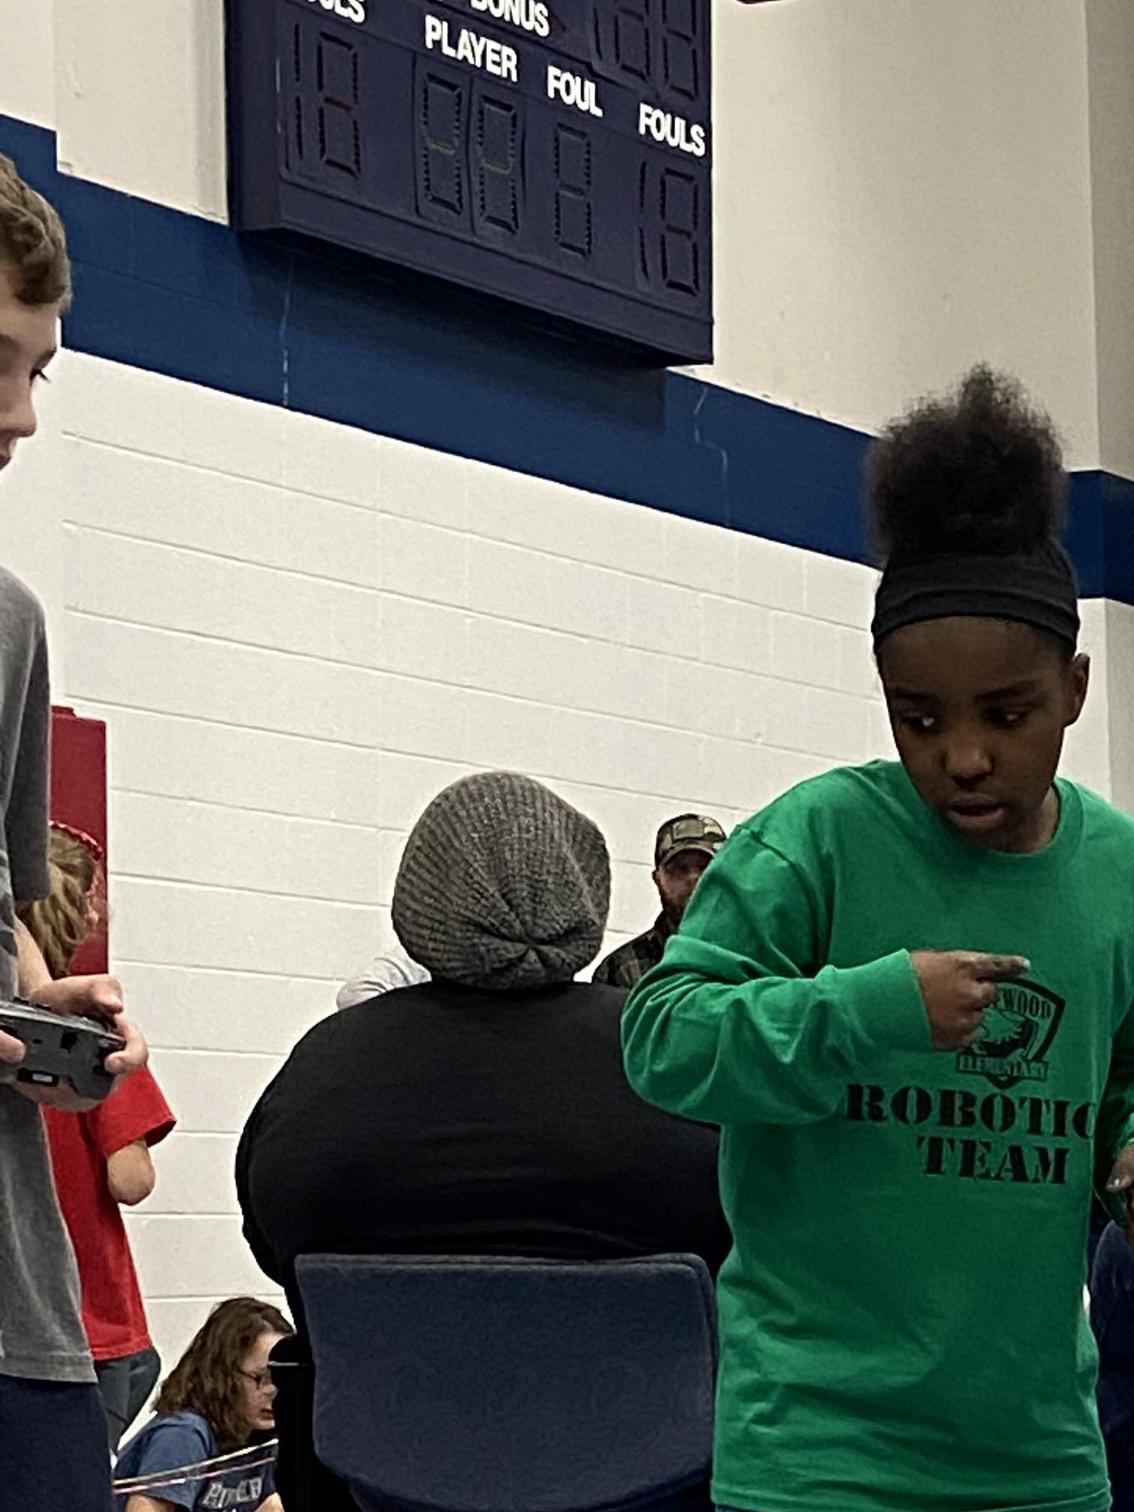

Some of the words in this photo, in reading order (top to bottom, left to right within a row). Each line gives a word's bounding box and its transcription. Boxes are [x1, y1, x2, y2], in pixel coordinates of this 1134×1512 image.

[425, 14, 518, 82] PLAYER
[547, 66, 602, 117] FOUL
[638, 103, 706, 157] FOULS
[916, 1134, 1071, 1185] TEAM
